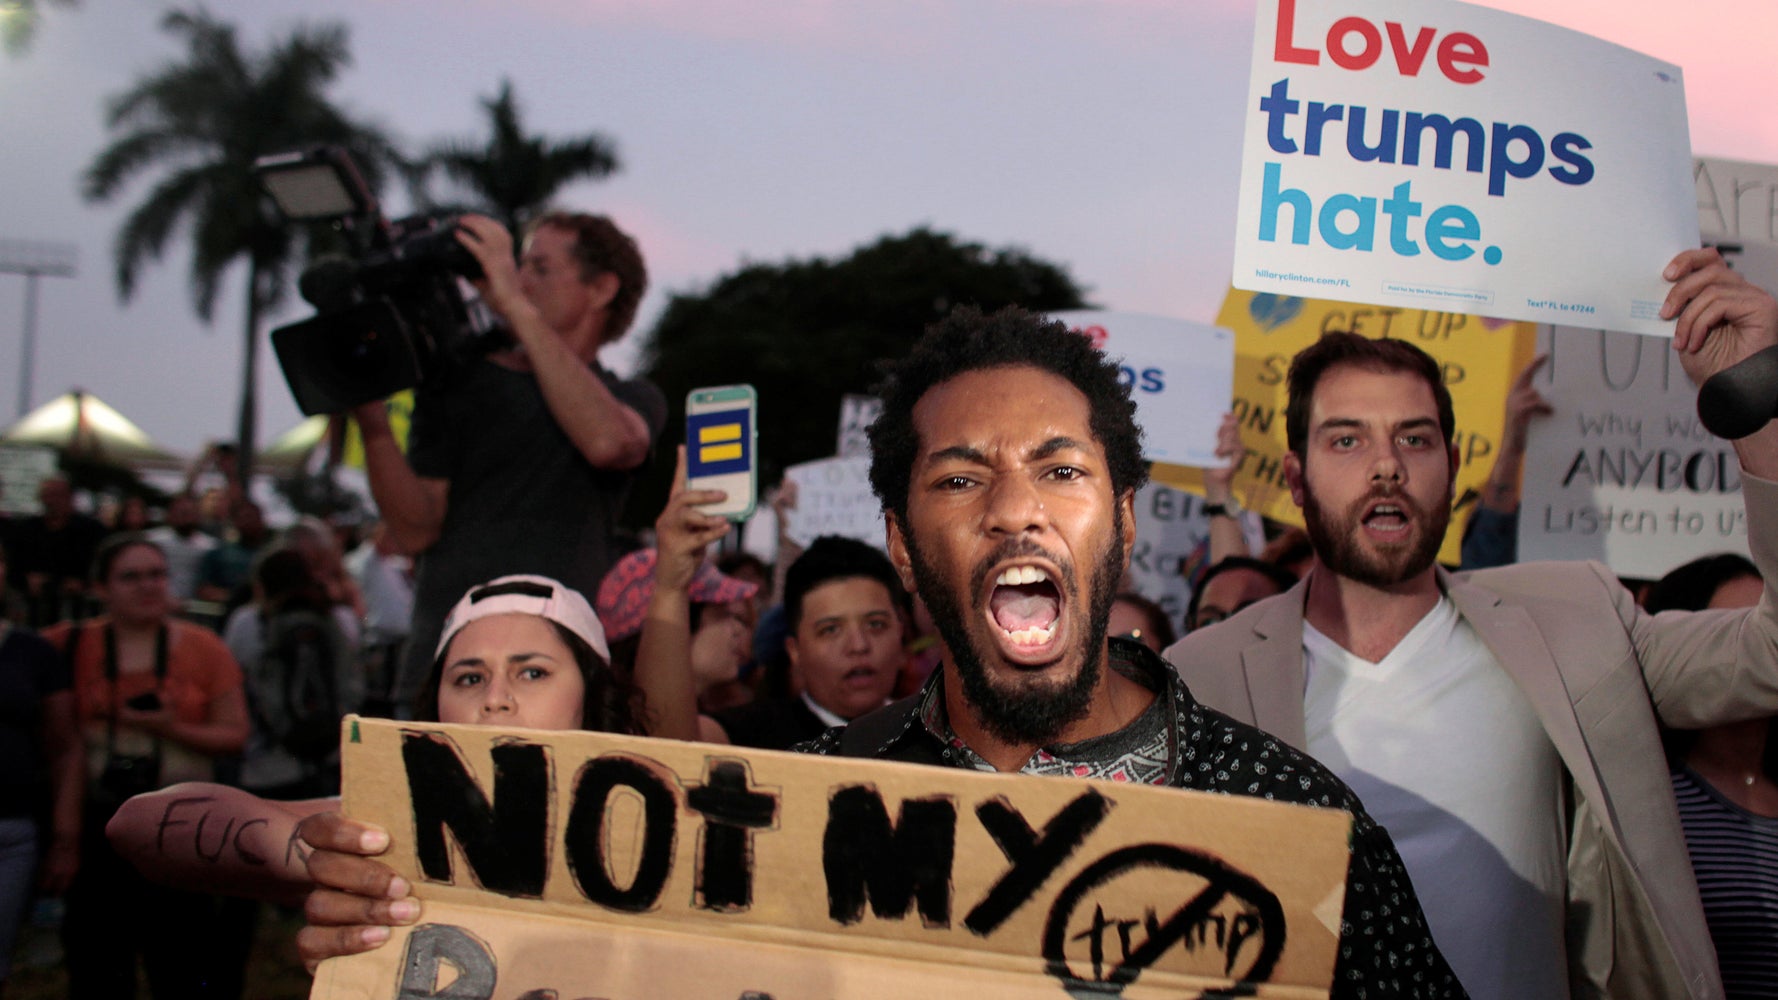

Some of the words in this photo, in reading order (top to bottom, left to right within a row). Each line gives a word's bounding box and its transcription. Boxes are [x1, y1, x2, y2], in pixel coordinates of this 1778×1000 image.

[1274, 0, 1490, 85] Love
[1260, 78, 1595, 197] trumps
[1258, 162, 1503, 266] hate.
[1255, 269, 1351, 288] hillaryclinton.com/FL
[1418, 309, 1467, 339] UP
[1668, 504, 1704, 535] to
[822, 782, 1117, 938] MY
